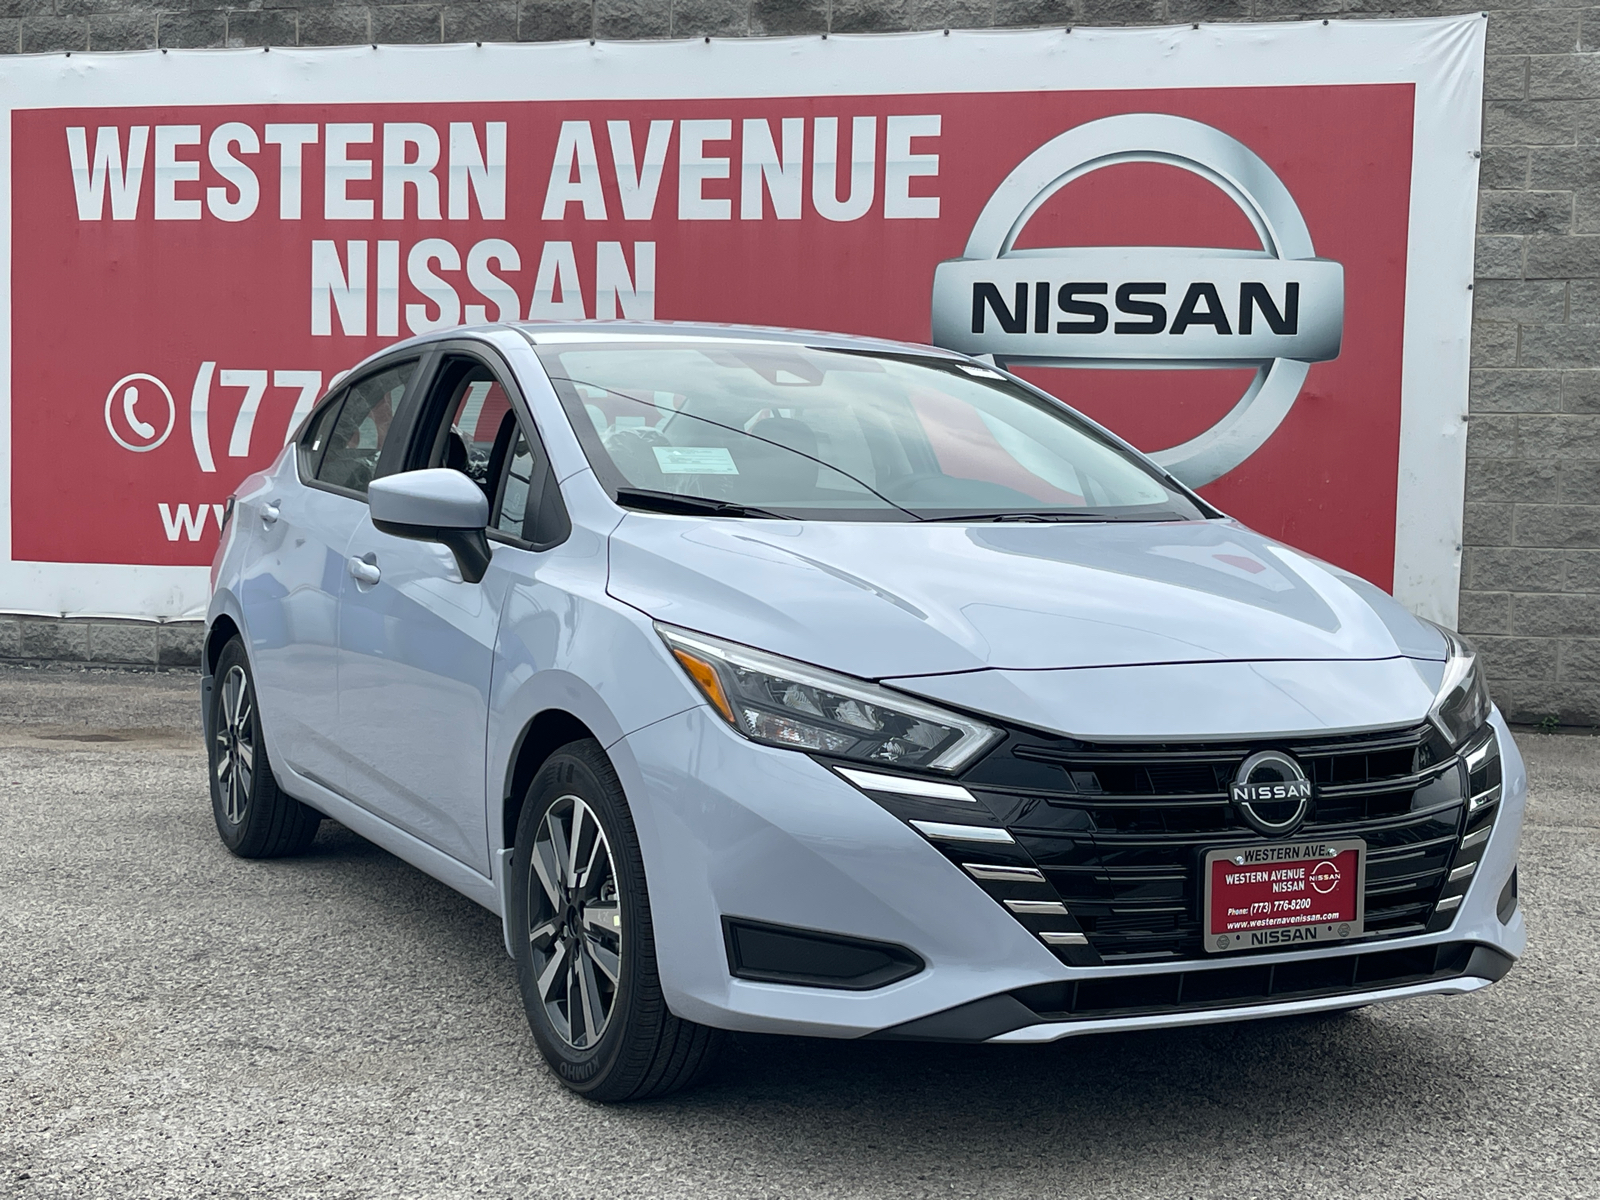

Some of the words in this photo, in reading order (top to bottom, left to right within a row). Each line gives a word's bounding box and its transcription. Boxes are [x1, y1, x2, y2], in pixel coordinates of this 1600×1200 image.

[66, 121, 507, 222] WESTERN
[541, 114, 941, 222] AVENUE
[311, 238, 656, 337] NISSAN
[972, 281, 1300, 336] NISSAN
[190, 361, 351, 473] (77
[1233, 783, 1311, 800] NISSAN
[1244, 846, 1300, 863] WESTERN
[1225, 871, 1269, 885] WESTERN
[1270, 868, 1305, 881] AVENUE
[1309, 873, 1341, 882] NISSAN
[1272, 880, 1305, 893] NISSAN
[1227, 907, 1249, 916] Phone:
[1250, 901, 1271, 916] (773)
[1273, 898, 1311, 912] 776-8200
[1227, 912, 1340, 930] www.westernavenissan.com
[1251, 927, 1317, 945] NISSAN
[560, 1055, 600, 1080] KUMHO
